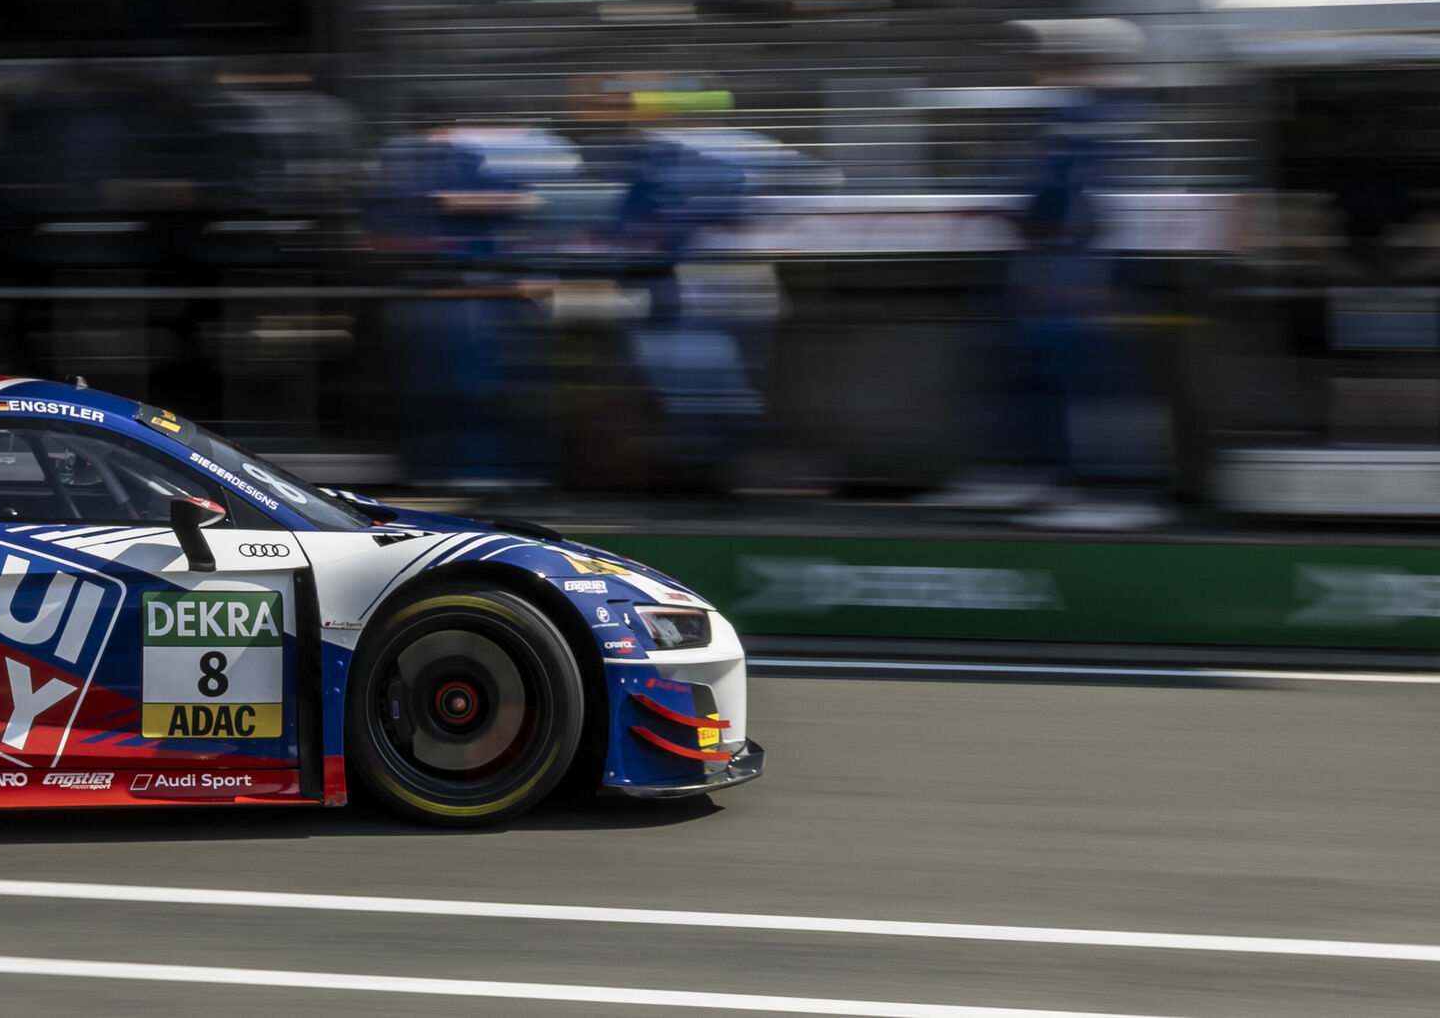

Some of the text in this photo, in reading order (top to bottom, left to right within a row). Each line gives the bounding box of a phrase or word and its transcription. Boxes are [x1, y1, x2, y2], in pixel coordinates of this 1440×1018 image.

[7, 400, 105, 423] ENGSTLER
[190, 452, 279, 511] SIEGERDESIGNS
[147, 601, 279, 637] DEKRA
[197, 650, 229, 698] 8
[168, 705, 256, 737] ADAC
[155, 773, 252, 789] Audi Sport
